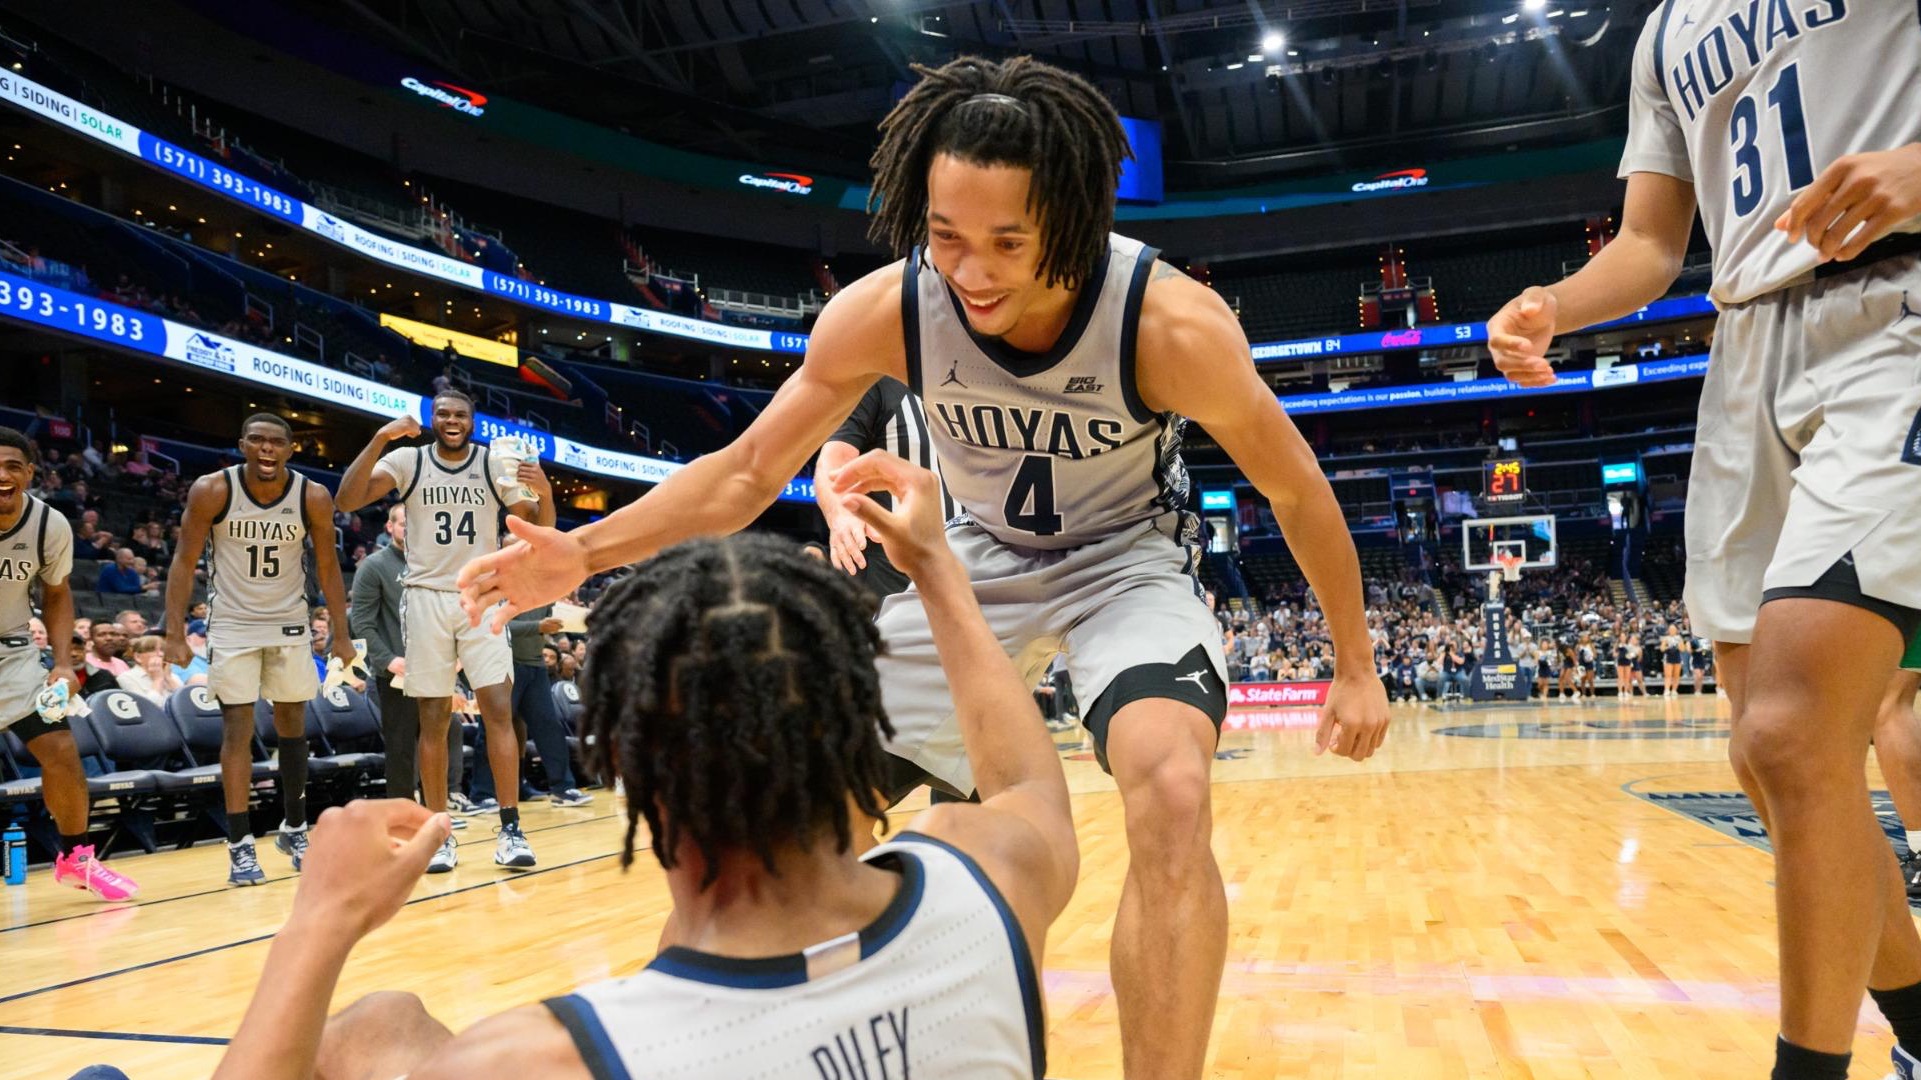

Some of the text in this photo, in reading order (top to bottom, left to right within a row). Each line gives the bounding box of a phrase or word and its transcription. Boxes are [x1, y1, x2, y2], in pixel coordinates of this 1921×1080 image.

[1672, 0, 1847, 122] HOYAS
[22, 86, 70, 117] SIDING
[81, 112, 122, 140] SOLAR
[155, 141, 205, 178] (571)
[212, 168, 292, 215] 393-1983
[1730, 60, 1815, 218] 31
[354, 233, 394, 257] ROOFING
[401, 251, 435, 268] SIDING
[441, 262, 472, 279] SOLAR
[493, 275, 530, 299] (571)
[535, 288, 600, 316] 393-1983
[660, 318, 696, 332] ROOFING
[701, 326, 728, 338] SIDING
[0, 281, 143, 341] 393-1983
[1252, 341, 1322, 359] GEORGETOWN
[1455, 326, 1471, 339] 53
[253, 357, 312, 386] ROOFING
[323, 378, 363, 400] SIDING
[372, 392, 407, 411] SOLAR
[1065, 383, 1104, 392] EAST
[1069, 376, 1096, 384] BIG
[1319, 394, 1366, 406] expectations
[1375, 393, 1389, 401] our
[1424, 388, 1456, 397] building
[1458, 382, 1507, 394] relationships
[1643, 363, 1687, 376] Exceeding
[935, 402, 1123, 459] HOYAS
[596, 456, 635, 472] ROOFING
[642, 463, 670, 477] SIDING
[1492, 473, 1518, 493] 27
[423, 486, 485, 506] HOYAS
[1004, 455, 1064, 536] 4
[229, 520, 297, 541] HOYAS
[434, 510, 477, 545] 34
[245, 545, 280, 578] 15
[1482, 674, 1517, 683] MedStar
[1485, 681, 1514, 690] Health
[107, 692, 142, 719] G
